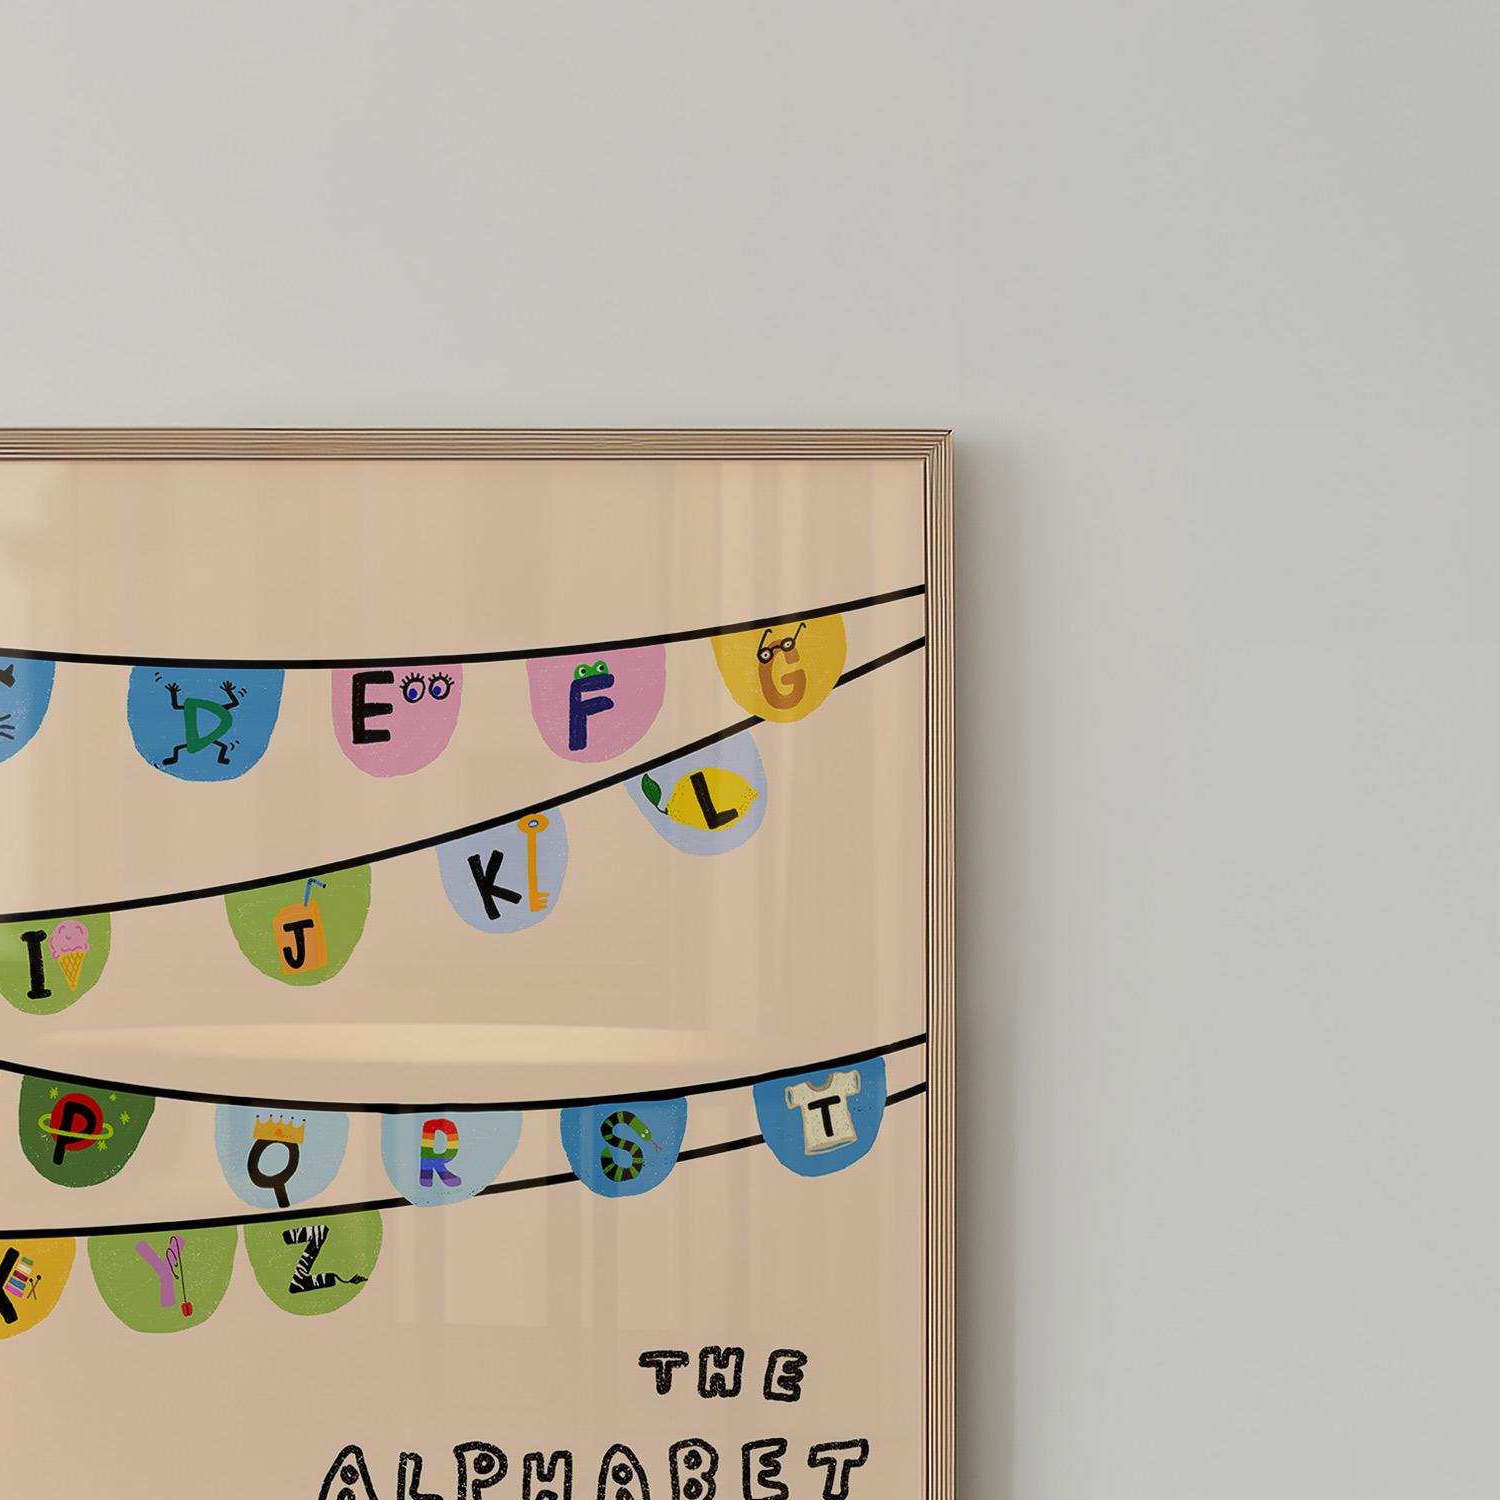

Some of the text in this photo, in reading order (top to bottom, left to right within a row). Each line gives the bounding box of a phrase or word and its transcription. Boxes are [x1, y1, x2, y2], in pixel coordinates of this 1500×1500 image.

[184, 699, 233, 753] D
[352, 670, 394, 744] E
[569, 674, 614, 750] F
[757, 639, 806, 709] G
[20, 929, 51, 999] I
[282, 919, 314, 969] J
[467, 850, 522, 920] K
[689, 772, 739, 829] L
[52, 1101, 97, 1165] P
[247, 1137, 300, 1208] Q
[419, 1118, 462, 1188] R
[600, 1110, 651, 1183] S
[808, 1095, 841, 1138] T
[135, 1237, 185, 1308] Y
[282, 1224, 337, 1293] Z
[638, 1345, 808, 1403] THE
